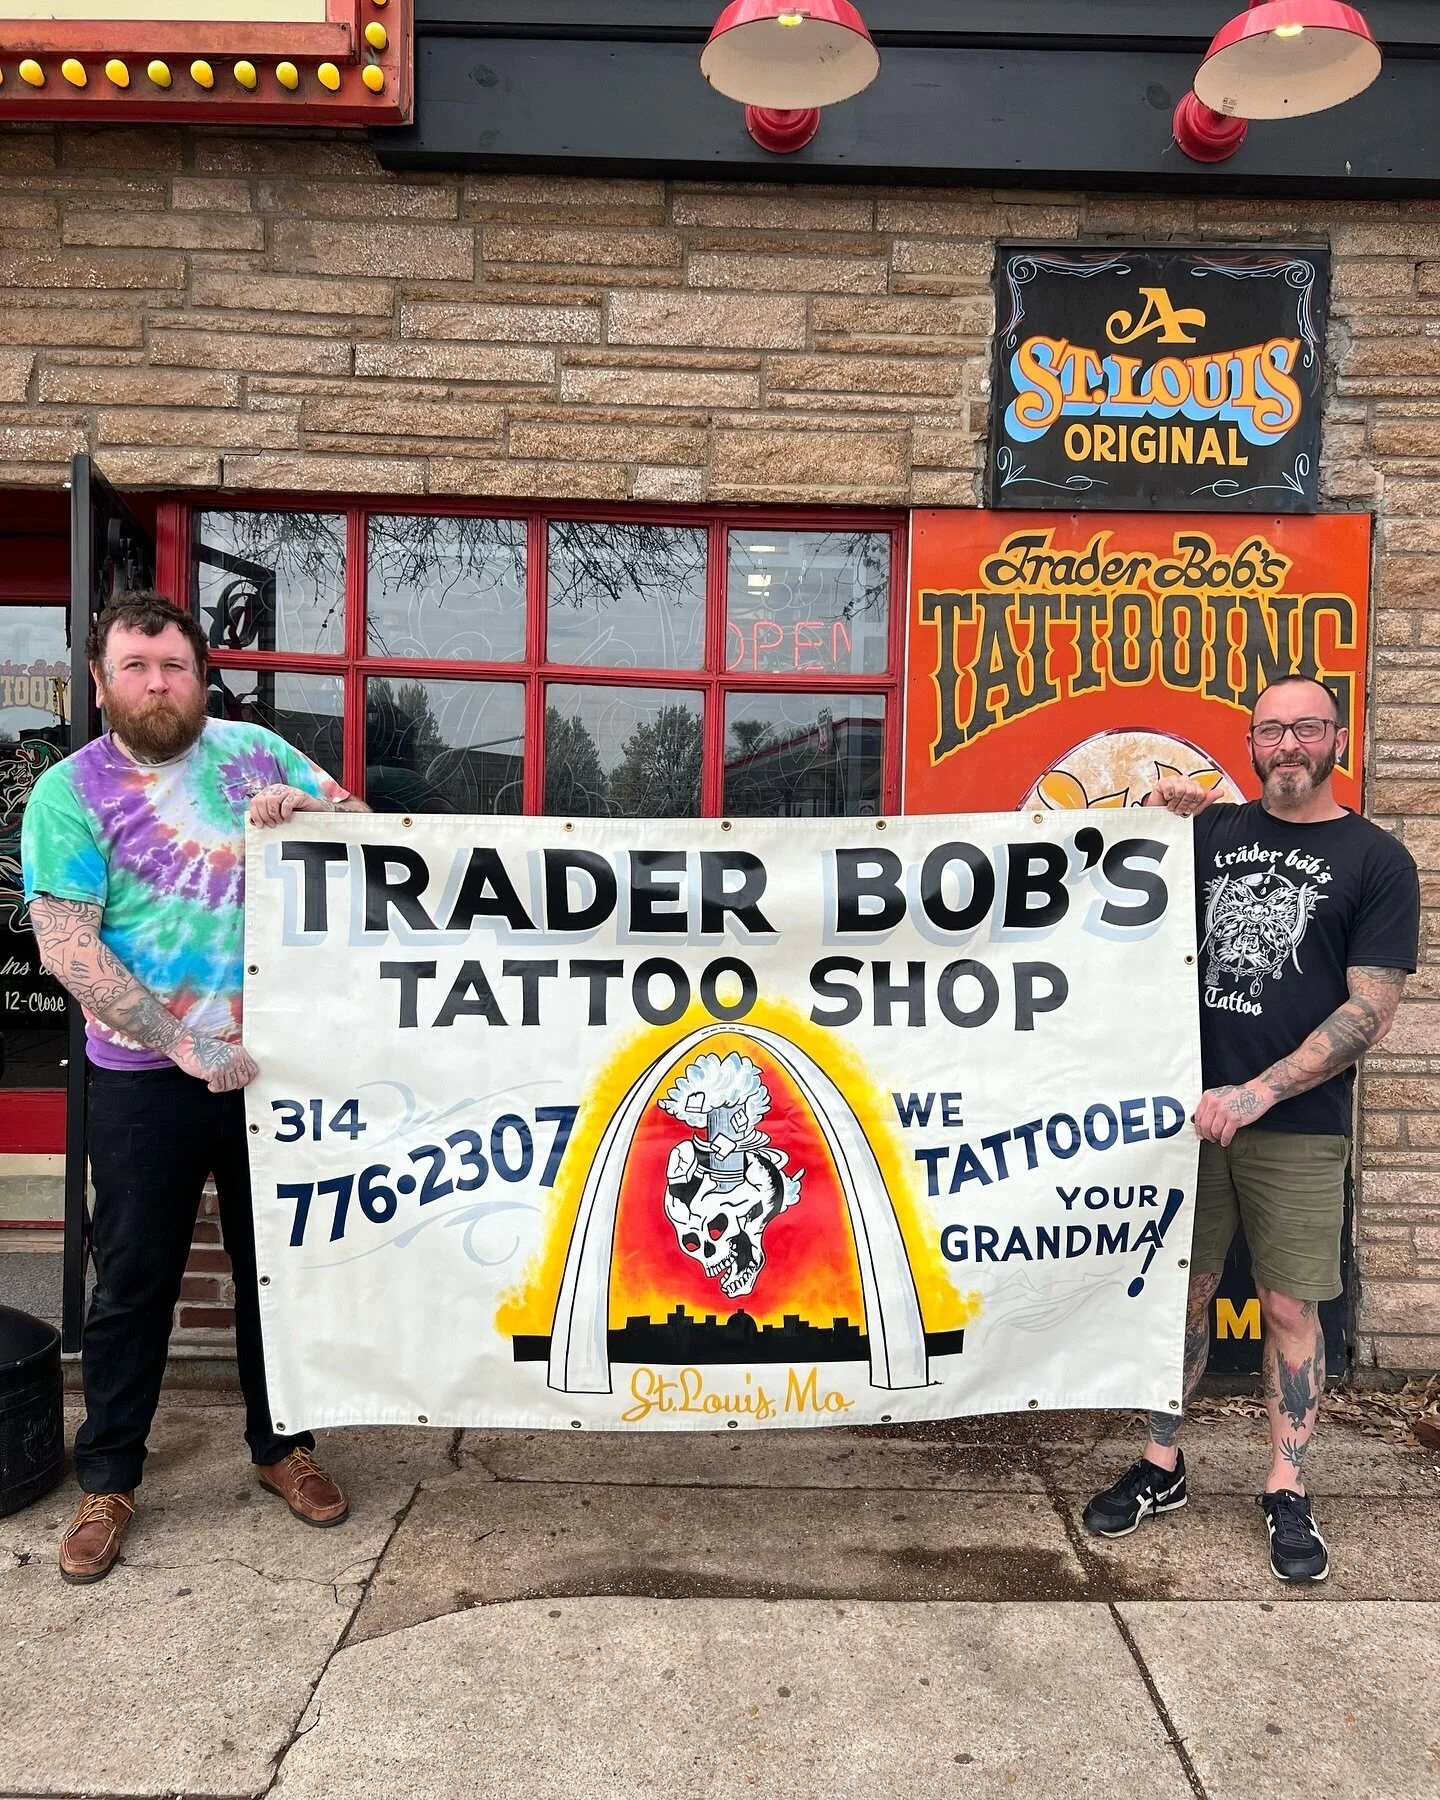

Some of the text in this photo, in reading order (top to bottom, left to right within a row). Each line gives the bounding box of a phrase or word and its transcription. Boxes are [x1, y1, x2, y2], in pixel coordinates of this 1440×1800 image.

[1105, 287, 1206, 344] A
[1064, 423, 1249, 466] ORIGINAL
[983, 530, 1288, 590] Trader Bob's
[1214, 842, 1283, 868] träder
[277, 827, 1170, 938] TRADER BOB'S
[5, 991, 66, 1012] 12-Close
[380, 956, 1069, 1031] TATTOO SHOP
[1205, 986, 1263, 1016] Tattoo
[271, 1099, 367, 1142] 314
[892, 1092, 963, 1128] WE
[915, 1095, 1186, 1196] TATTOOED
[1056, 1185, 1158, 1210] YOUR
